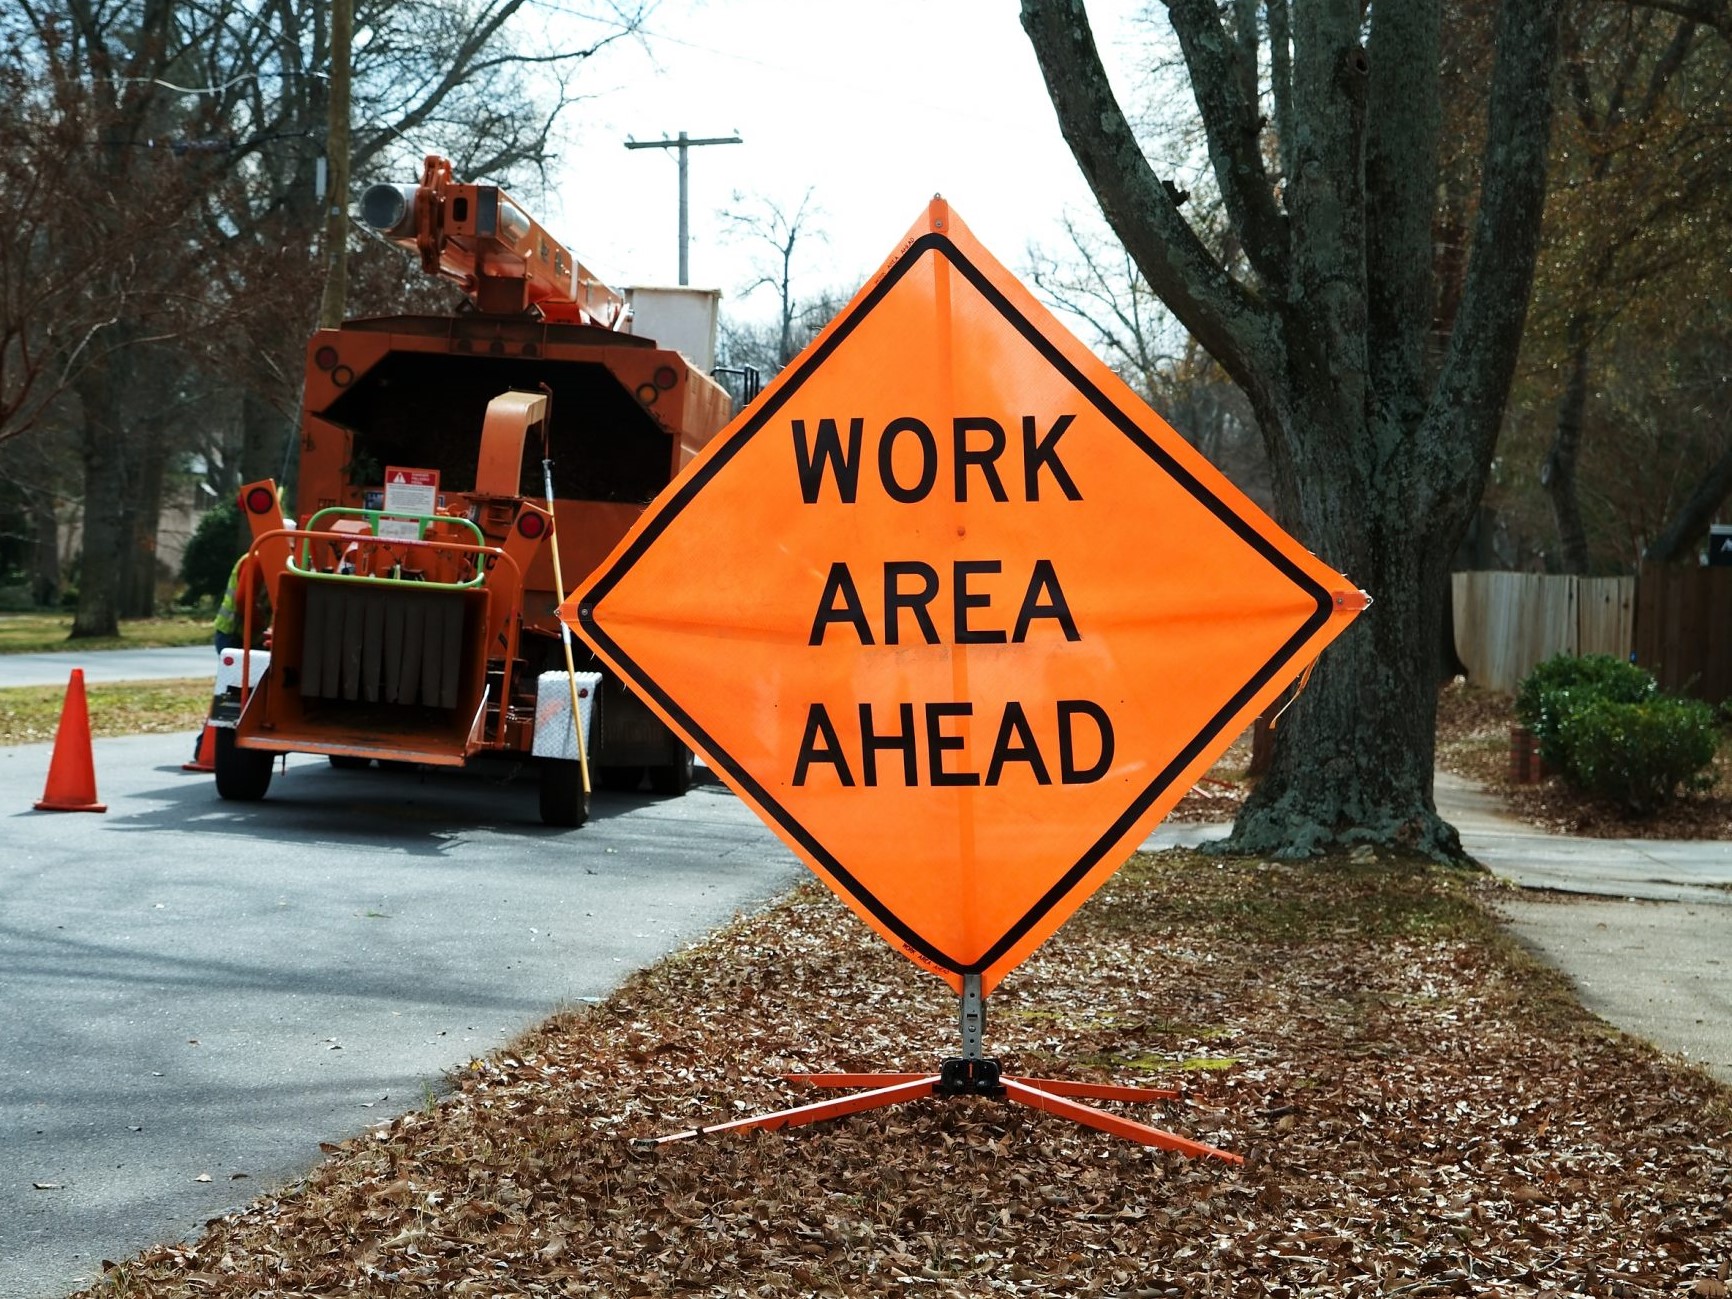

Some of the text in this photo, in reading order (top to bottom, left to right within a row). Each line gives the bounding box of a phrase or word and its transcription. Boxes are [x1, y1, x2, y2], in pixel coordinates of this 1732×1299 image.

[791, 415, 1084, 504] WORK
[808, 560, 1082, 646] AREA
[791, 700, 1115, 787] AHEAD
